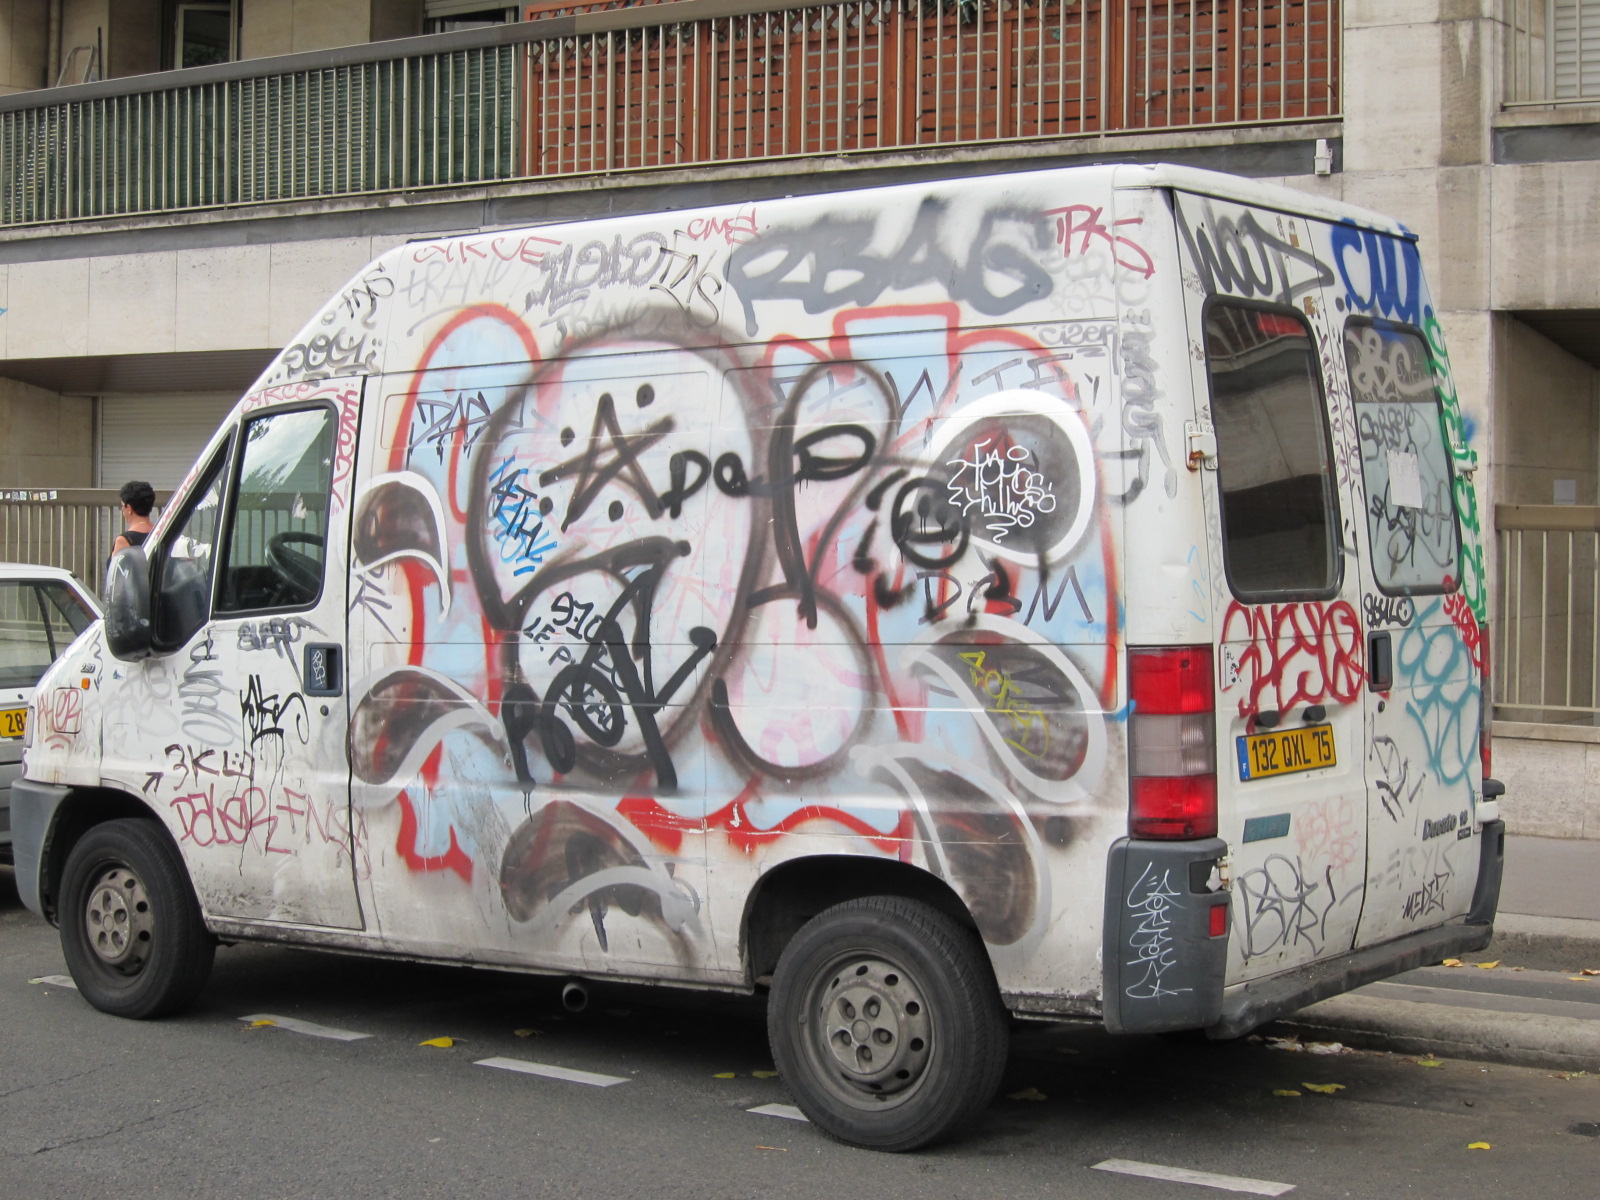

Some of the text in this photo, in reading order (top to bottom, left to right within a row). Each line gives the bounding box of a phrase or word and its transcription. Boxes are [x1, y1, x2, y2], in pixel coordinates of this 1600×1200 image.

[5, 712, 28, 733] 28
[1252, 737, 1279, 773] 132
[1281, 734, 1312, 768] QXL
[1312, 730, 1332, 762] 75
[1422, 812, 1458, 841] Ducato
